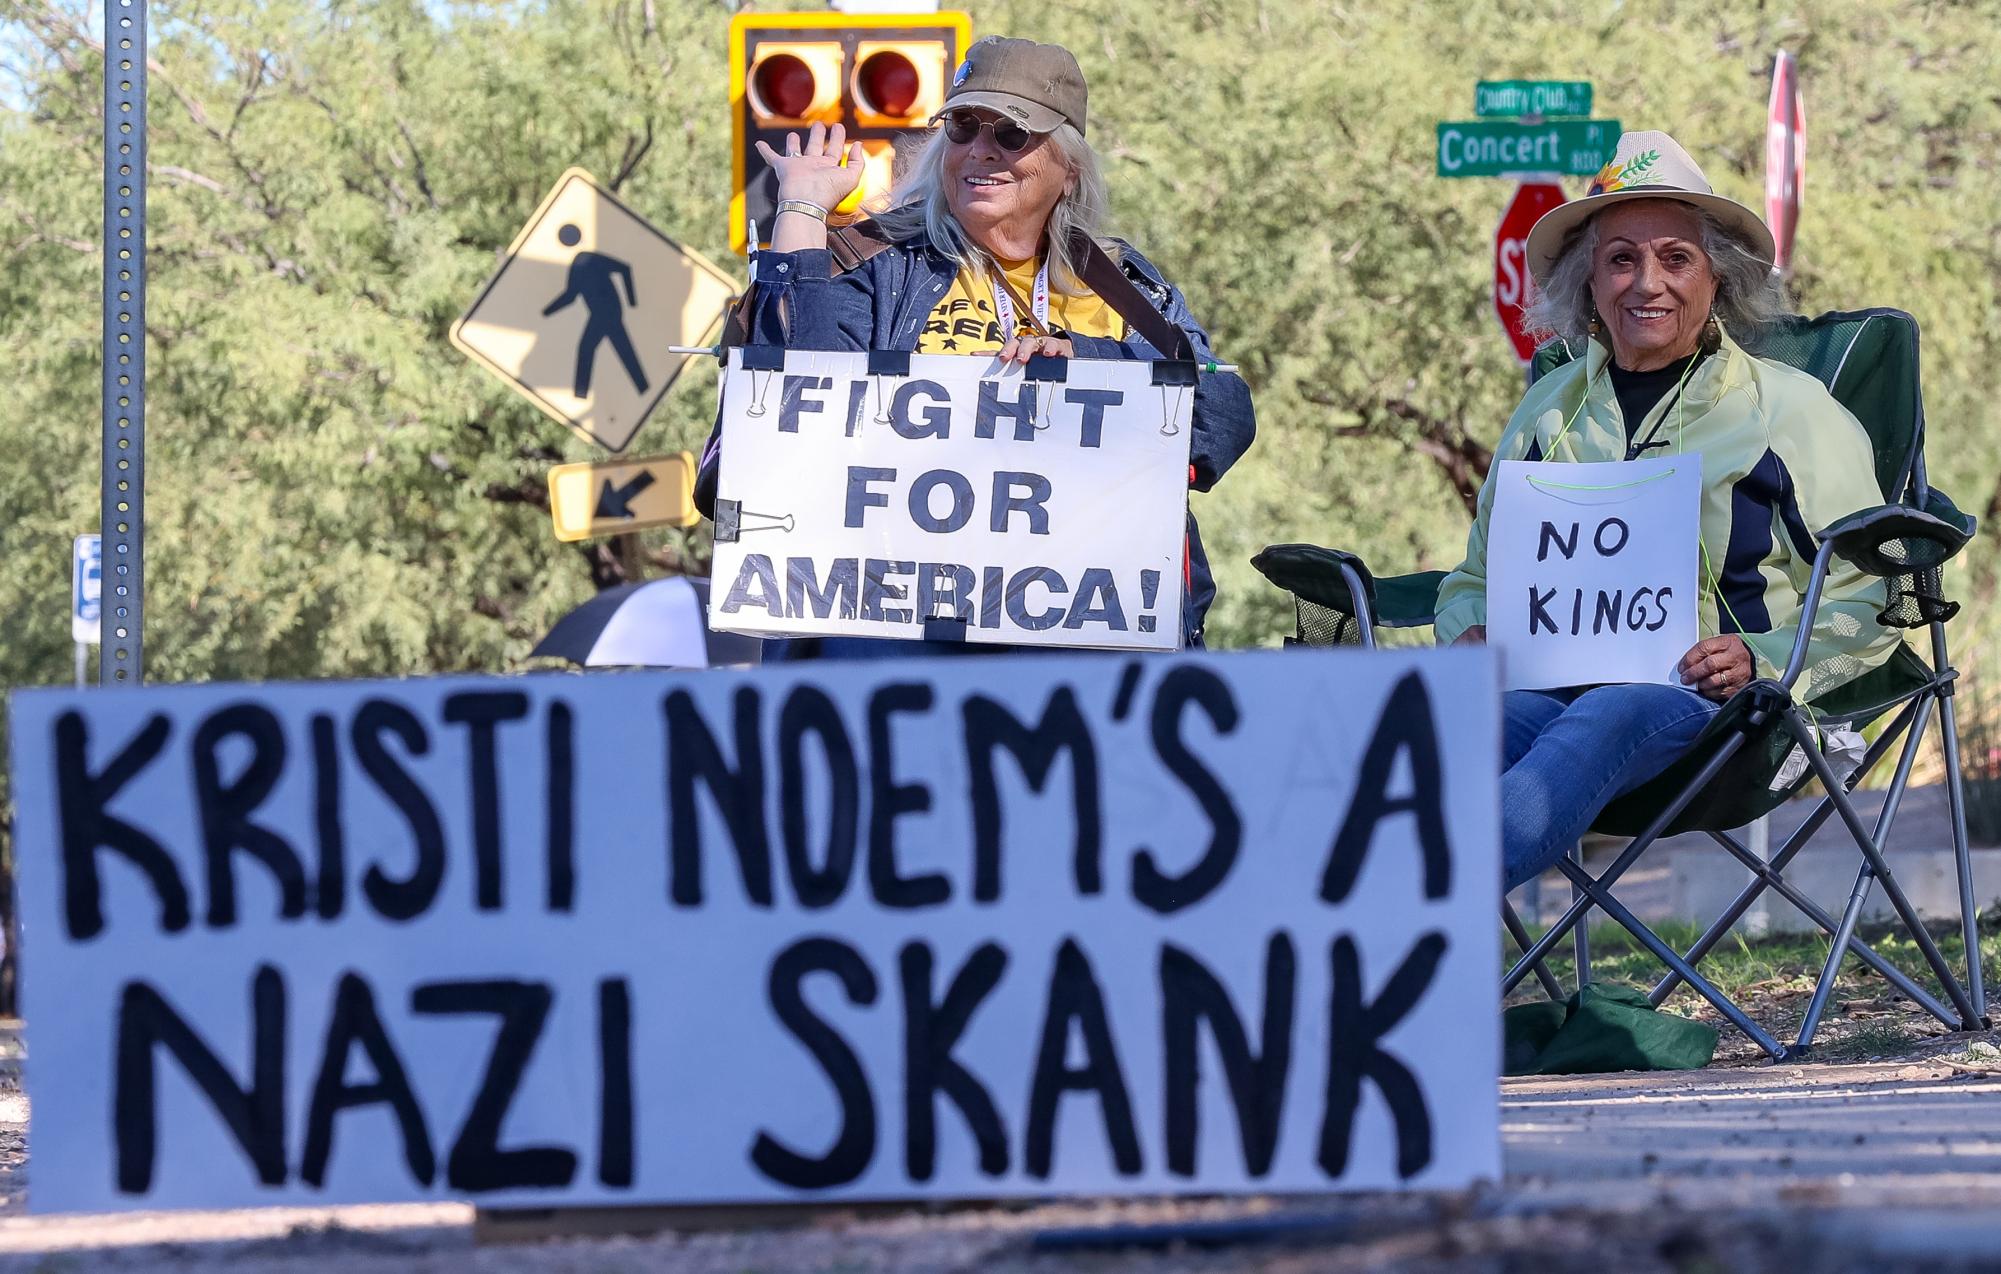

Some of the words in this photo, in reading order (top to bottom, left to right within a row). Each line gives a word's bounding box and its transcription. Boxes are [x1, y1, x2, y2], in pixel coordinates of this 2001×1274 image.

[1440, 129, 1560, 170] Concert
[778, 375, 1124, 449] FIGHT
[844, 466, 1053, 535] FOR
[1536, 517, 1630, 562] NO
[720, 553, 1161, 633] AMERICA!
[1528, 583, 1673, 636] KINGS
[54, 690, 578, 942] KRISTI
[662, 661, 1244, 915] NOEM'S
[1317, 667, 1453, 906] A
[112, 962, 636, 1197] NAZI
[748, 928, 1450, 1190] SKANK
